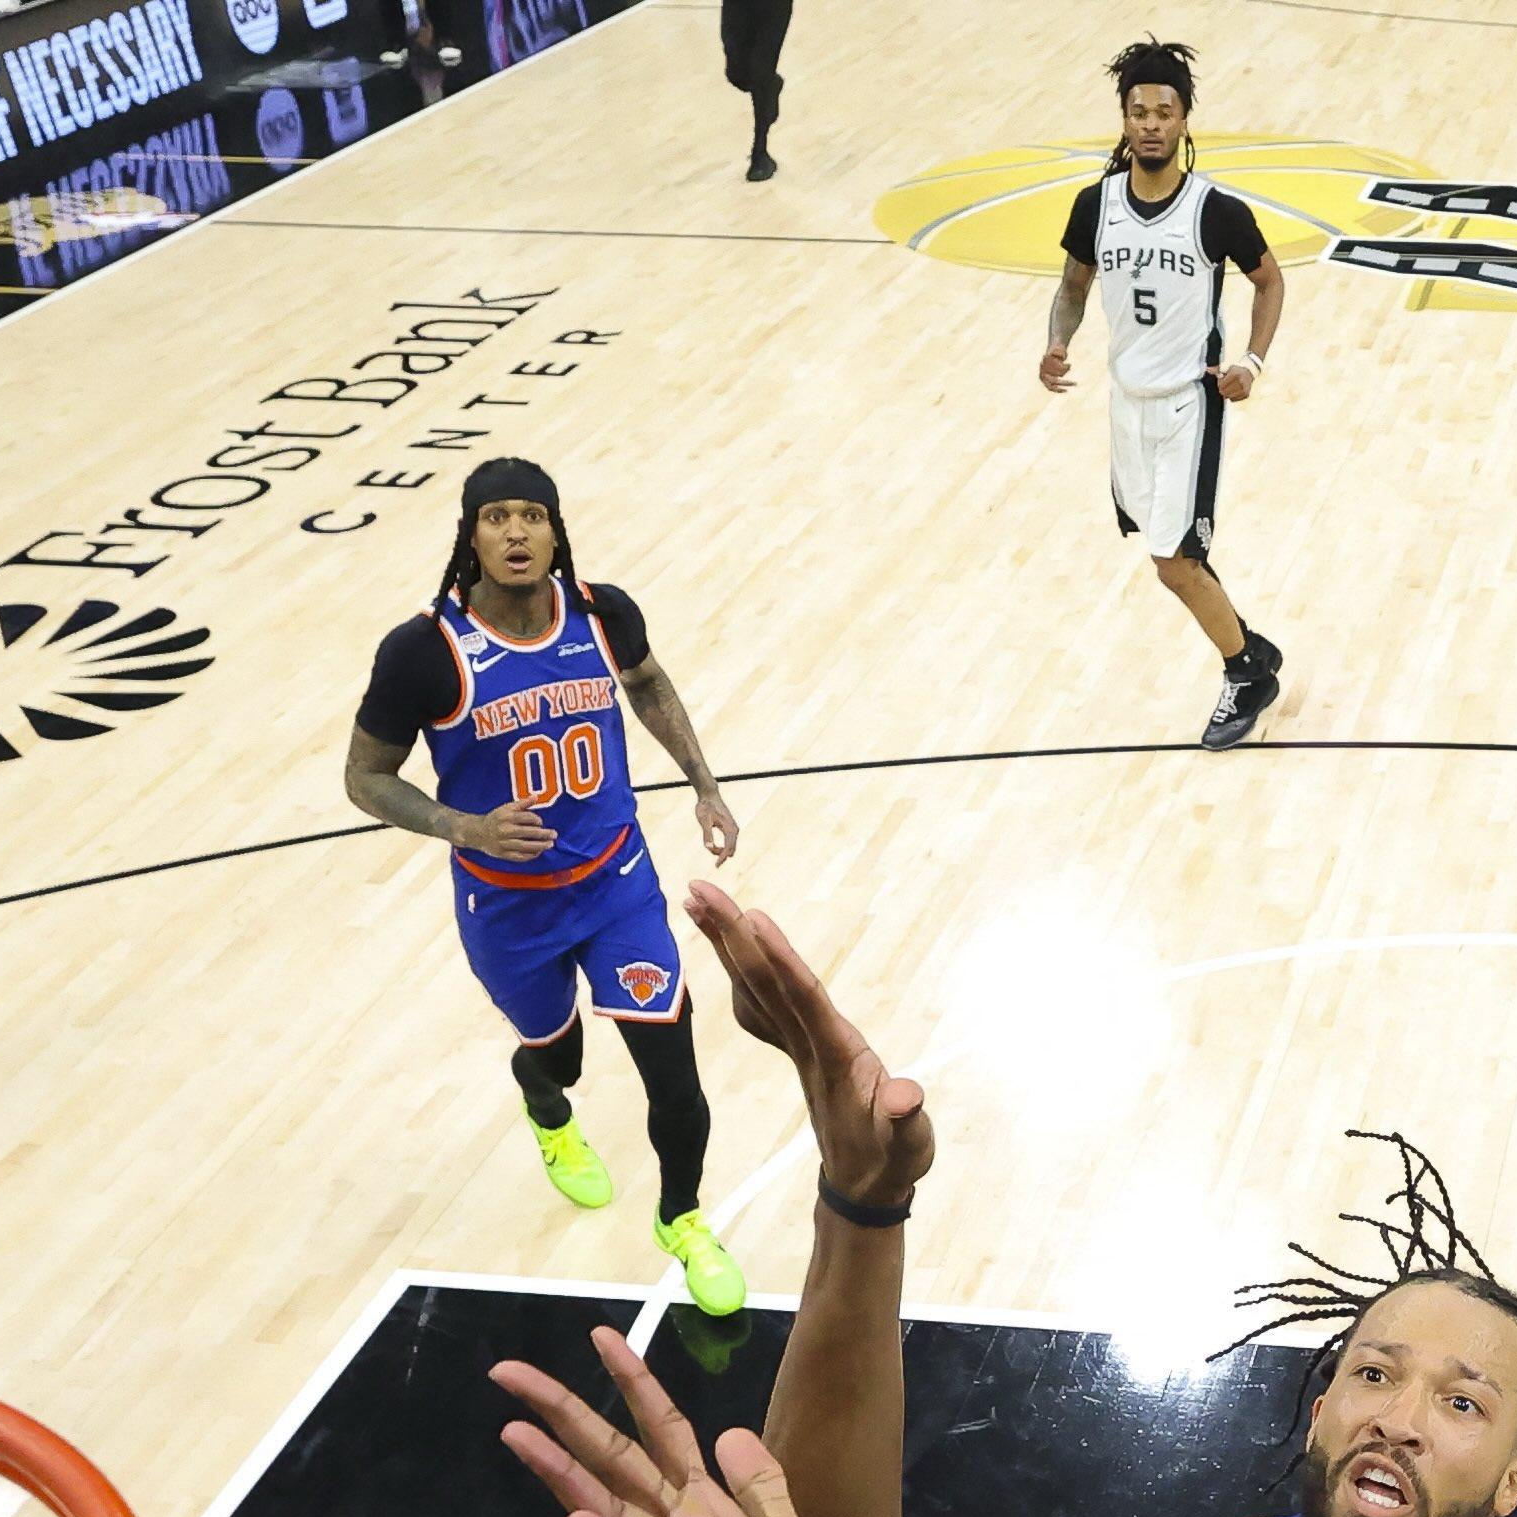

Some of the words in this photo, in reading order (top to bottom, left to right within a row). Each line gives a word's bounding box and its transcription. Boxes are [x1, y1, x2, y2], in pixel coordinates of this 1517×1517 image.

[3, 0, 203, 148] NECESSARY
[1102, 247, 1196, 279] SPURS
[1133, 287, 1158, 326] 5
[300, 328, 624, 535] CENTER
[471, 686, 541, 741] NEW
[539, 676, 617, 719] YORK
[508, 721, 605, 809] 00
